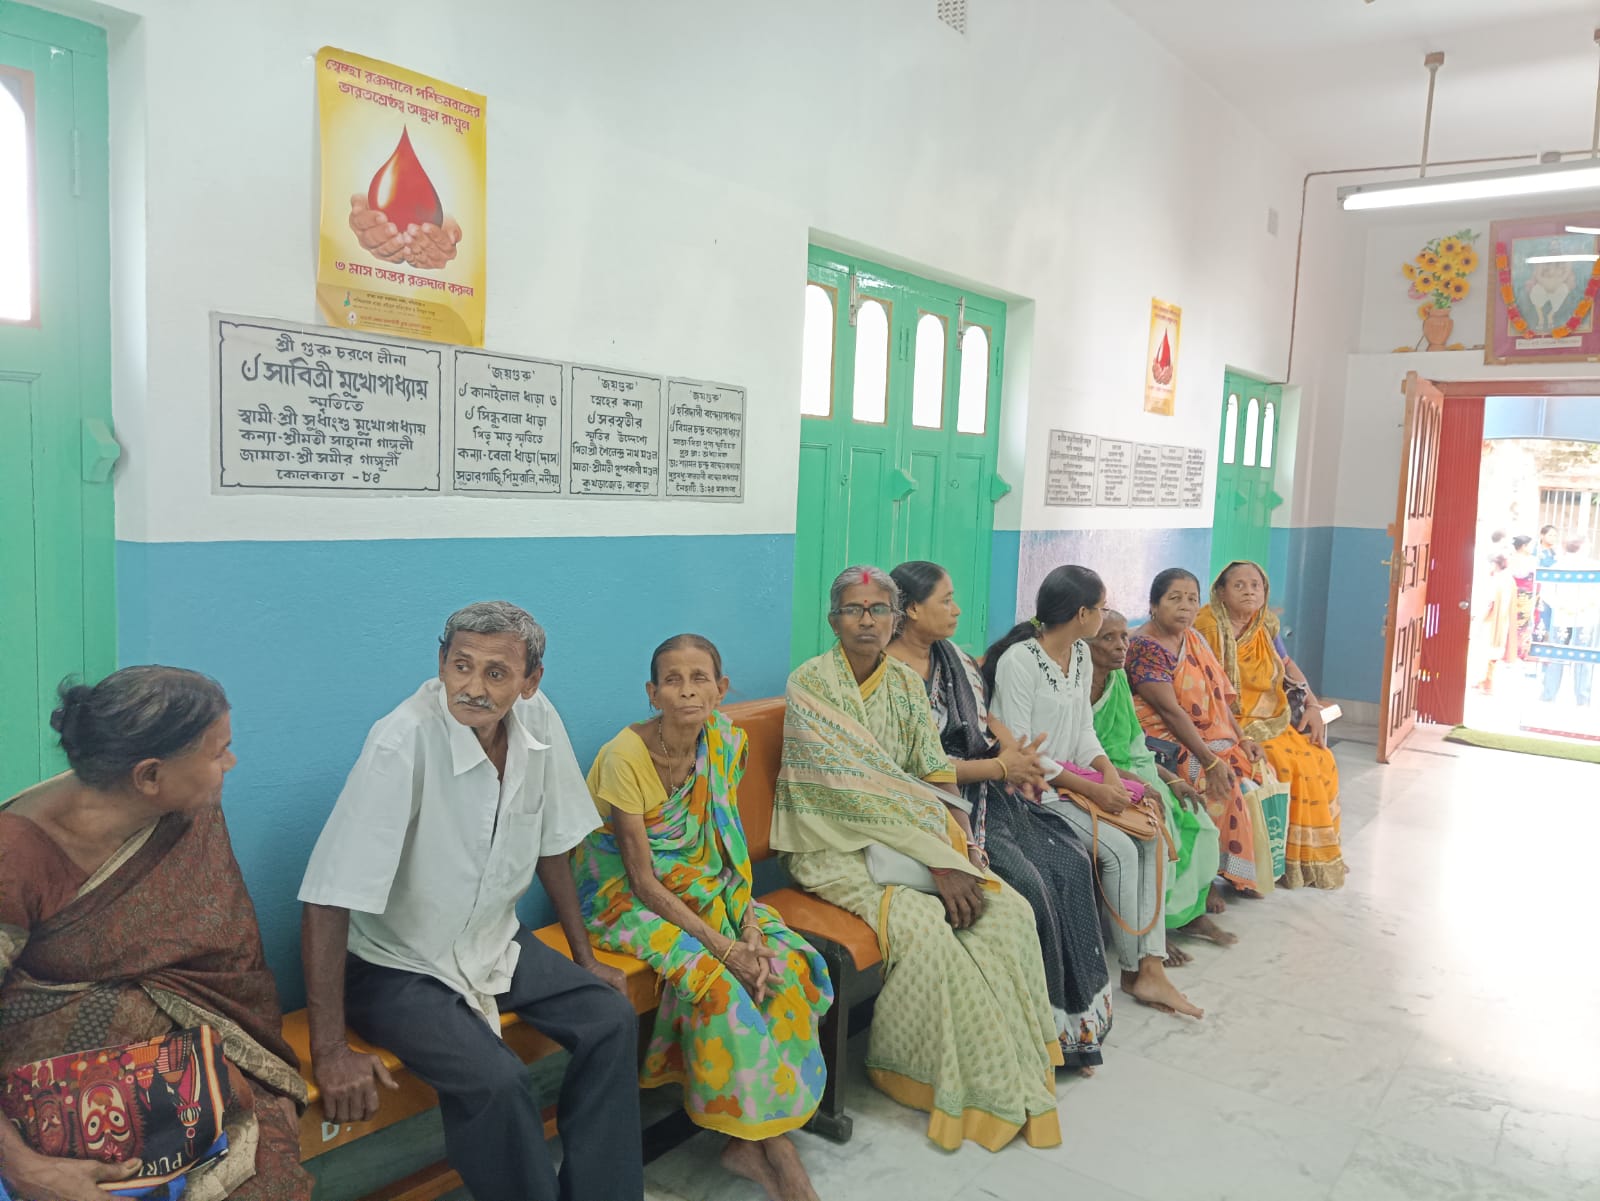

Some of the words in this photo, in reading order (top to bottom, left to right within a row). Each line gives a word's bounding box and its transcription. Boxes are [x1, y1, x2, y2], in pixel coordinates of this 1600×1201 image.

[335, 260, 346, 271] ৩
[349, 263, 372, 276] মাস
[375, 267, 405, 284] অন্তর
[408, 274, 446, 292] রক্তদান
[448, 283, 474, 297] করুন
[276, 333, 295, 352] শ্রী
[301, 343, 332, 358] গুরু
[335, 346, 373, 362] চরণে
[377, 347, 407, 366] লীনা
[317, 447, 353, 467] সমীর
[275, 468, 345, 482] কোলকাতা
[138, 1152, 183, 1177] PURI
